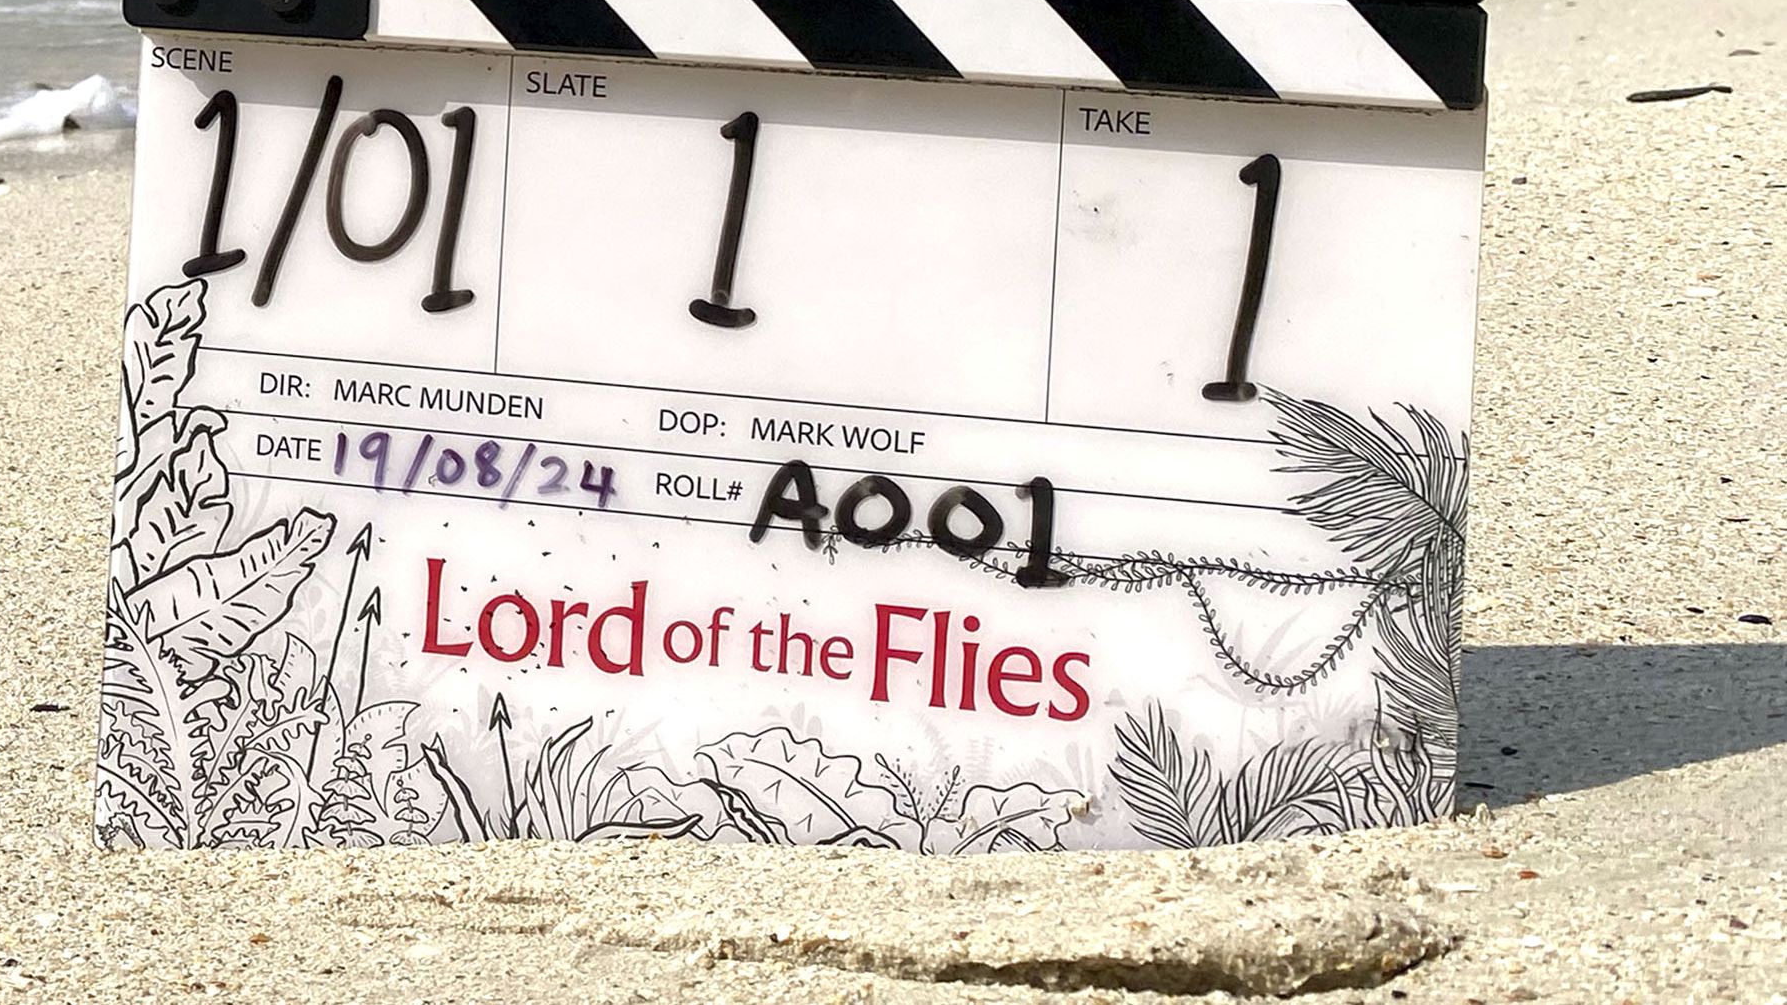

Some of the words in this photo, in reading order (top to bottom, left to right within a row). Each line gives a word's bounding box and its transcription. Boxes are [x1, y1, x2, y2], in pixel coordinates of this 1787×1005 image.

[151, 46, 233, 73] SCENE
[526, 71, 607, 98] SLATE
[1079, 107, 1152, 135] TAKE
[182, 75, 476, 312] 1/01
[688, 111, 759, 327] 1
[1201, 153, 1281, 402] 1
[259, 372, 311, 398] DIR:
[333, 379, 411, 408] MARC
[419, 387, 543, 420] MUNDEN
[256, 434, 322, 461] DATE
[659, 409, 726, 437] DOP:
[751, 417, 835, 447] MARK
[842, 426, 926, 454] WOLF
[333, 431, 617, 509] 19/08/24
[655, 473, 743, 501] ROLL#
[421, 558, 649, 677] Lord
[662, 606, 735, 667] of
[749, 613, 854, 680] the
[869, 603, 1091, 722] Flies
